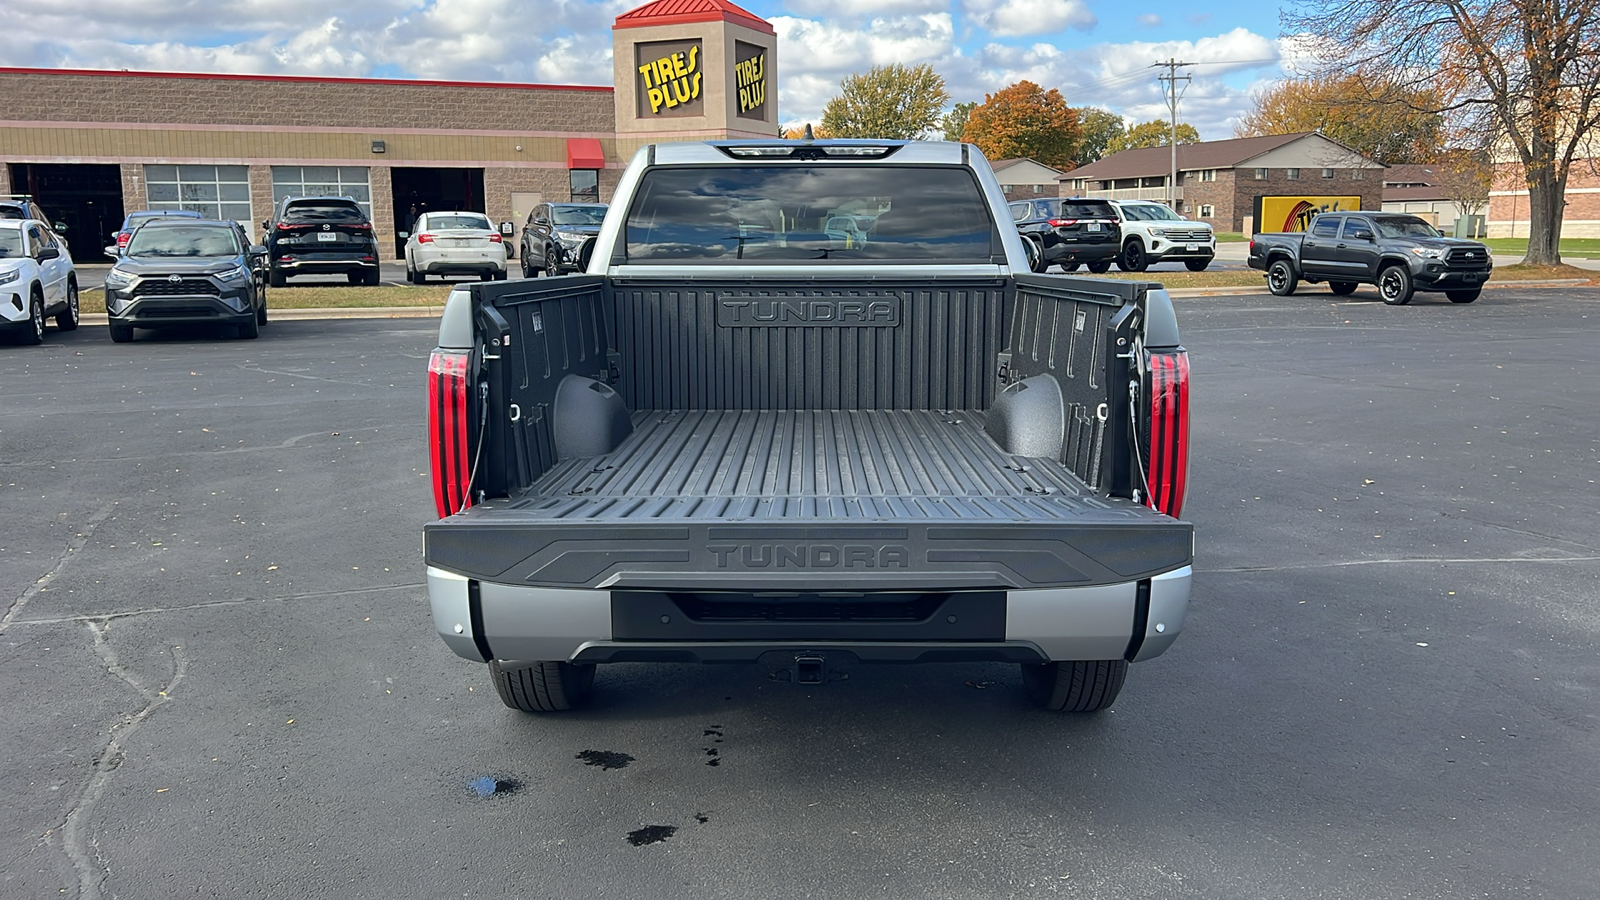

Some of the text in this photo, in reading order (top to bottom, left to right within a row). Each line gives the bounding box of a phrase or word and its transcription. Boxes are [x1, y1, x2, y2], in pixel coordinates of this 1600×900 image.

[639, 45, 699, 89] TIRES
[735, 54, 764, 88] TIRES
[648, 72, 702, 114] PLUS
[739, 79, 766, 114] PLUS
[723, 301, 895, 322] TUNDRA
[706, 544, 909, 568] TUNDRA
